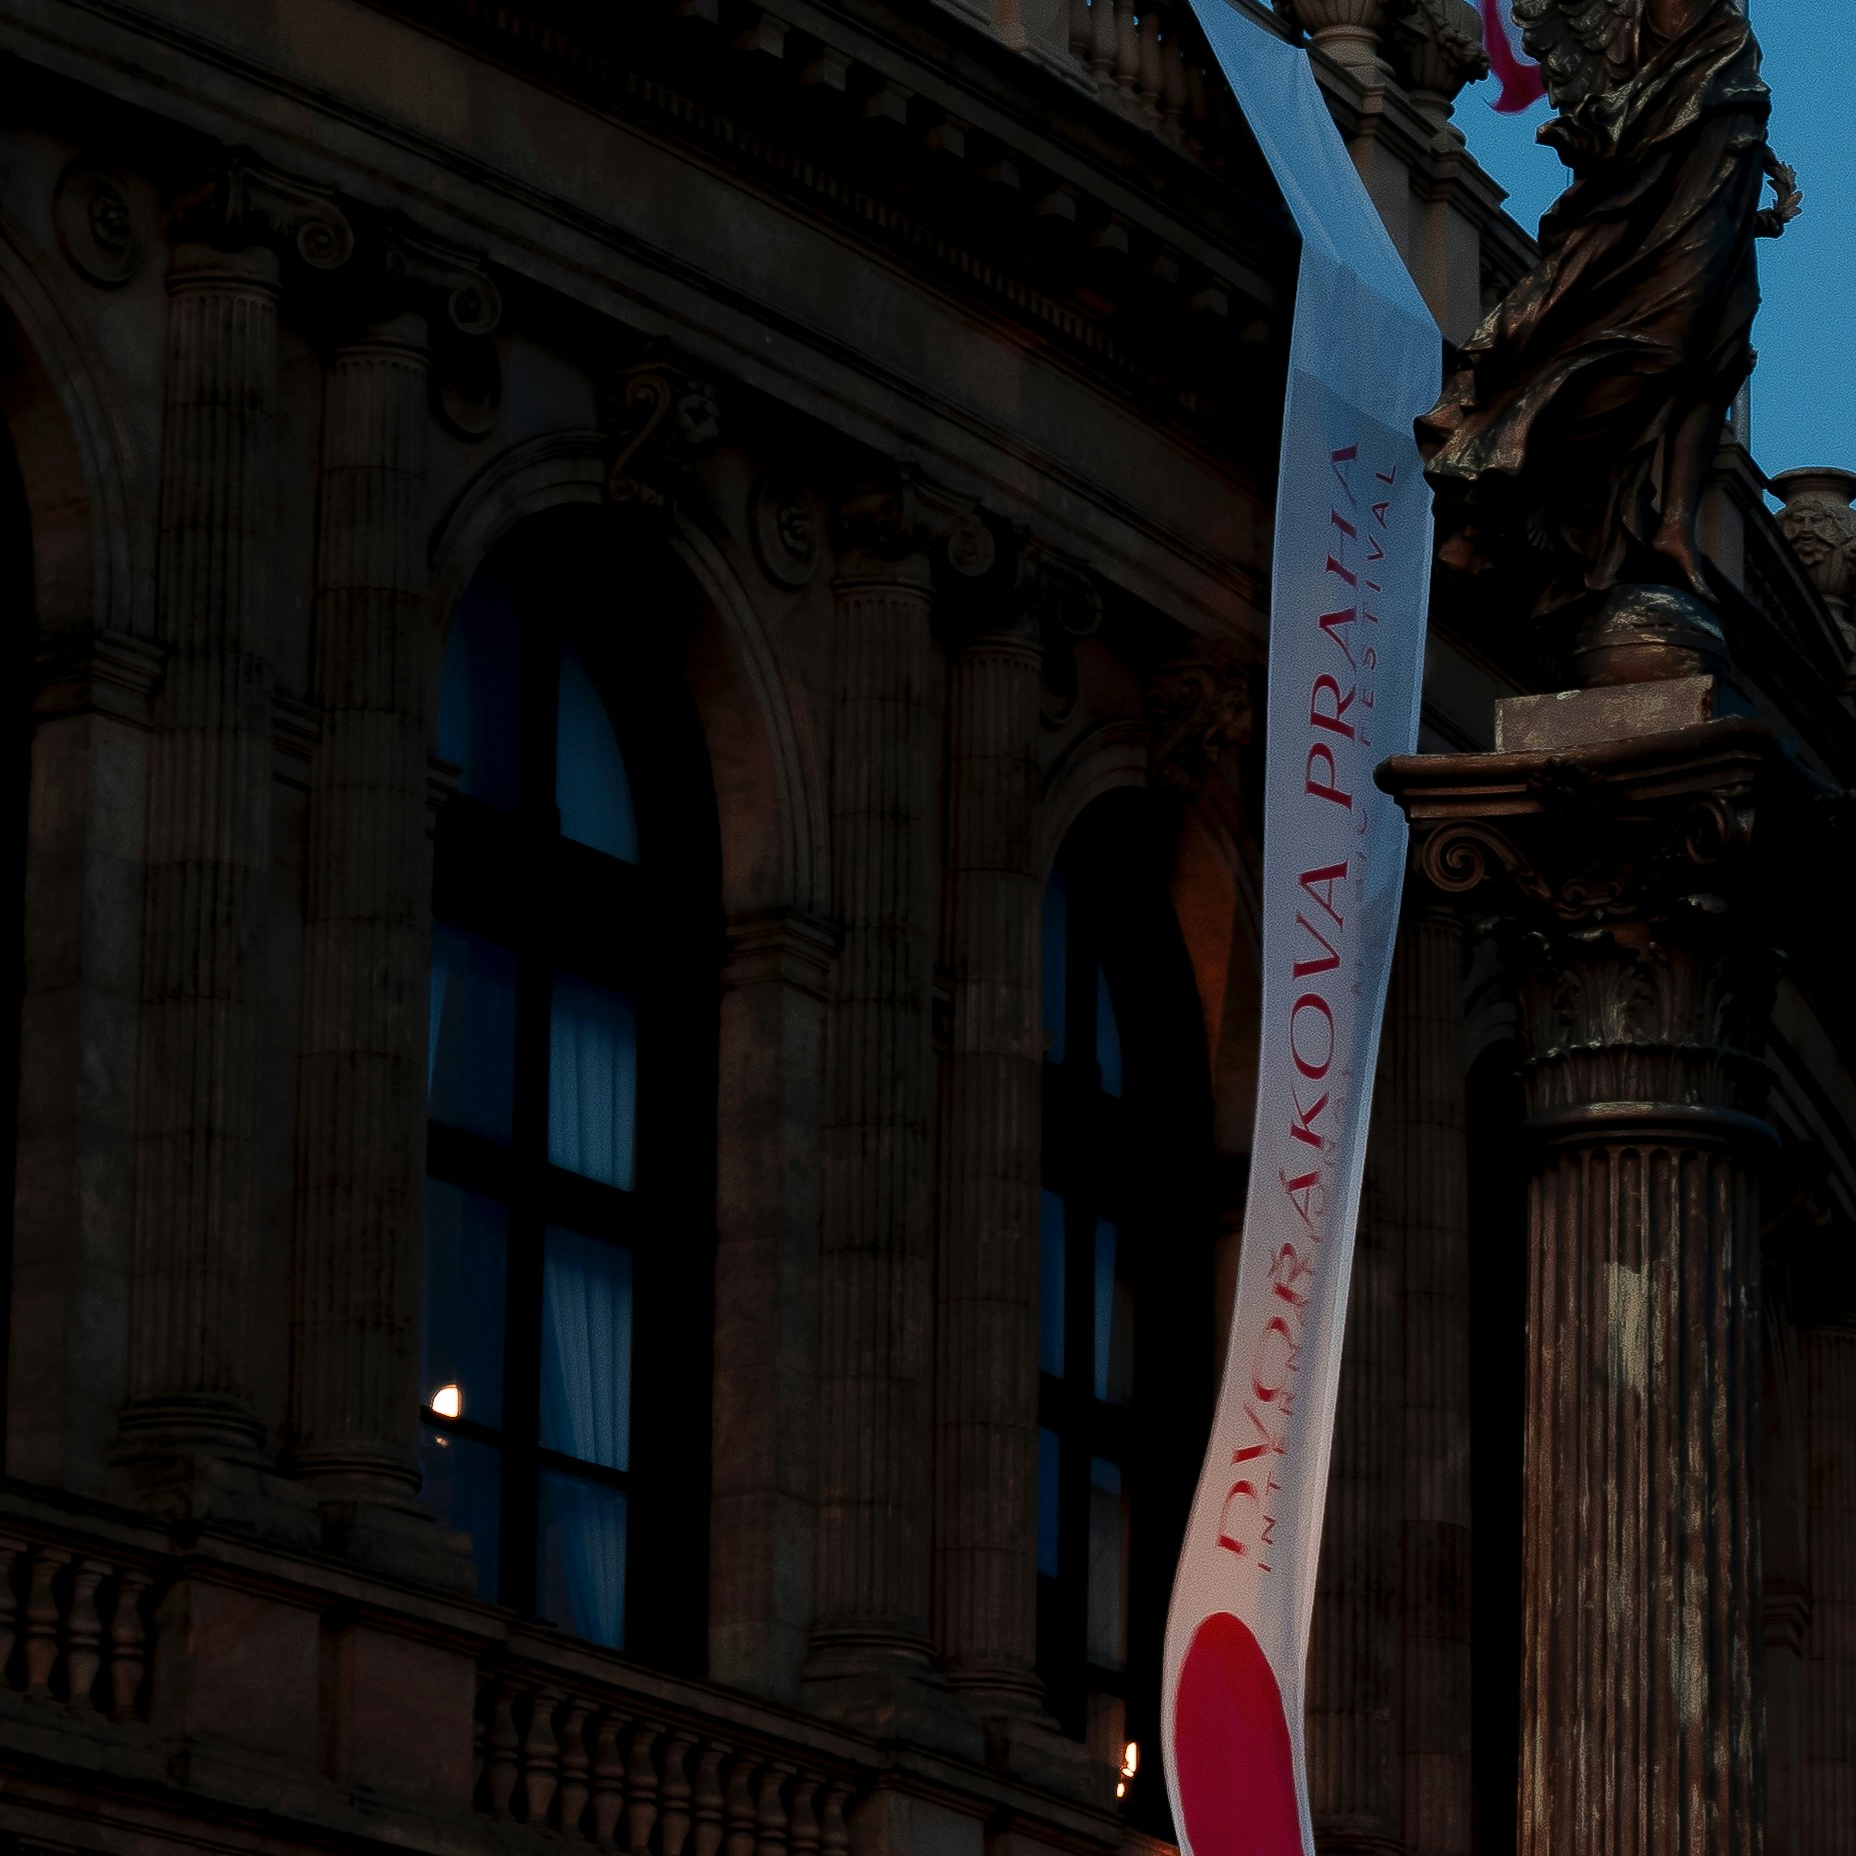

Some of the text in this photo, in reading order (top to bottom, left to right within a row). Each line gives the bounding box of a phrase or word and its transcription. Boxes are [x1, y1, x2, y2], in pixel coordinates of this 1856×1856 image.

[1357, 464, 1397, 748] FESTIVAL
[1217, 444, 1358, 1555] DVOŘÁKOVA PRAHA
